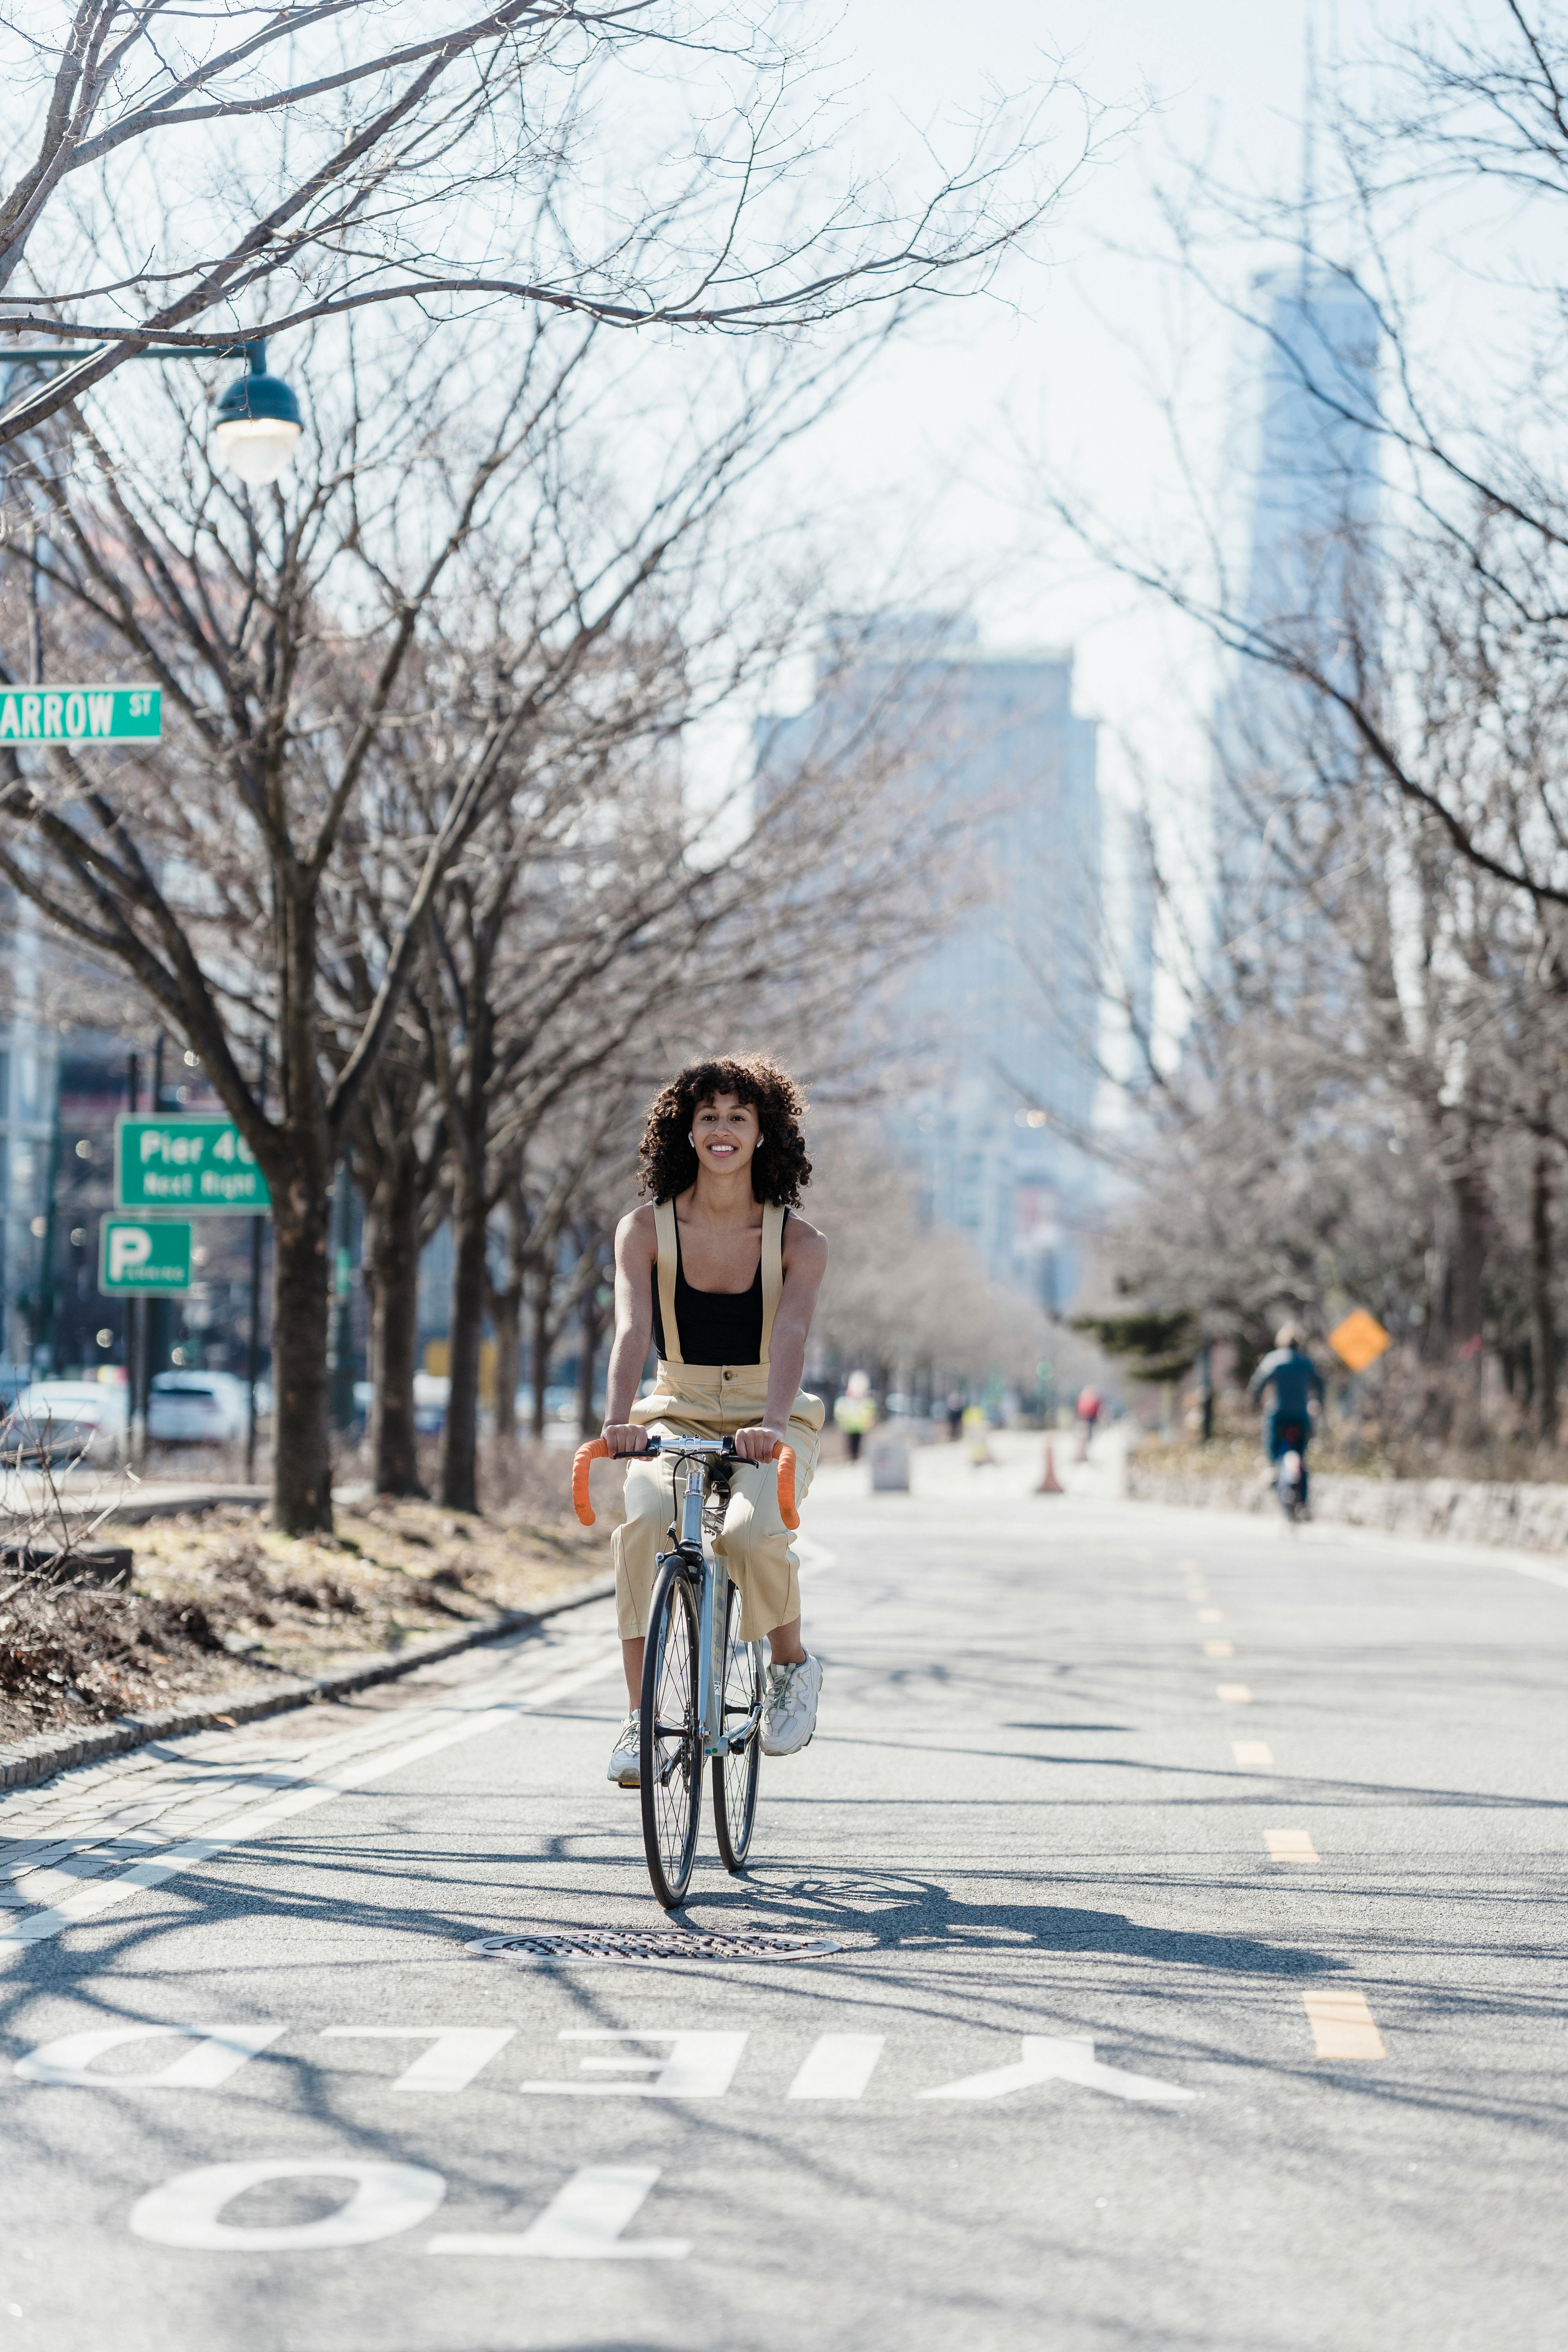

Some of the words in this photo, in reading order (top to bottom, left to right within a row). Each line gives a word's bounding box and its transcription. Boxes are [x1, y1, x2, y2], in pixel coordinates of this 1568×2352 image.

[0, 693, 115, 737] ARROW
[129, 692, 152, 717] ST
[140, 1130, 204, 1165] Pier
[14, 2024, 1200, 2100] YIELD
[130, 2158, 688, 2262] TO
